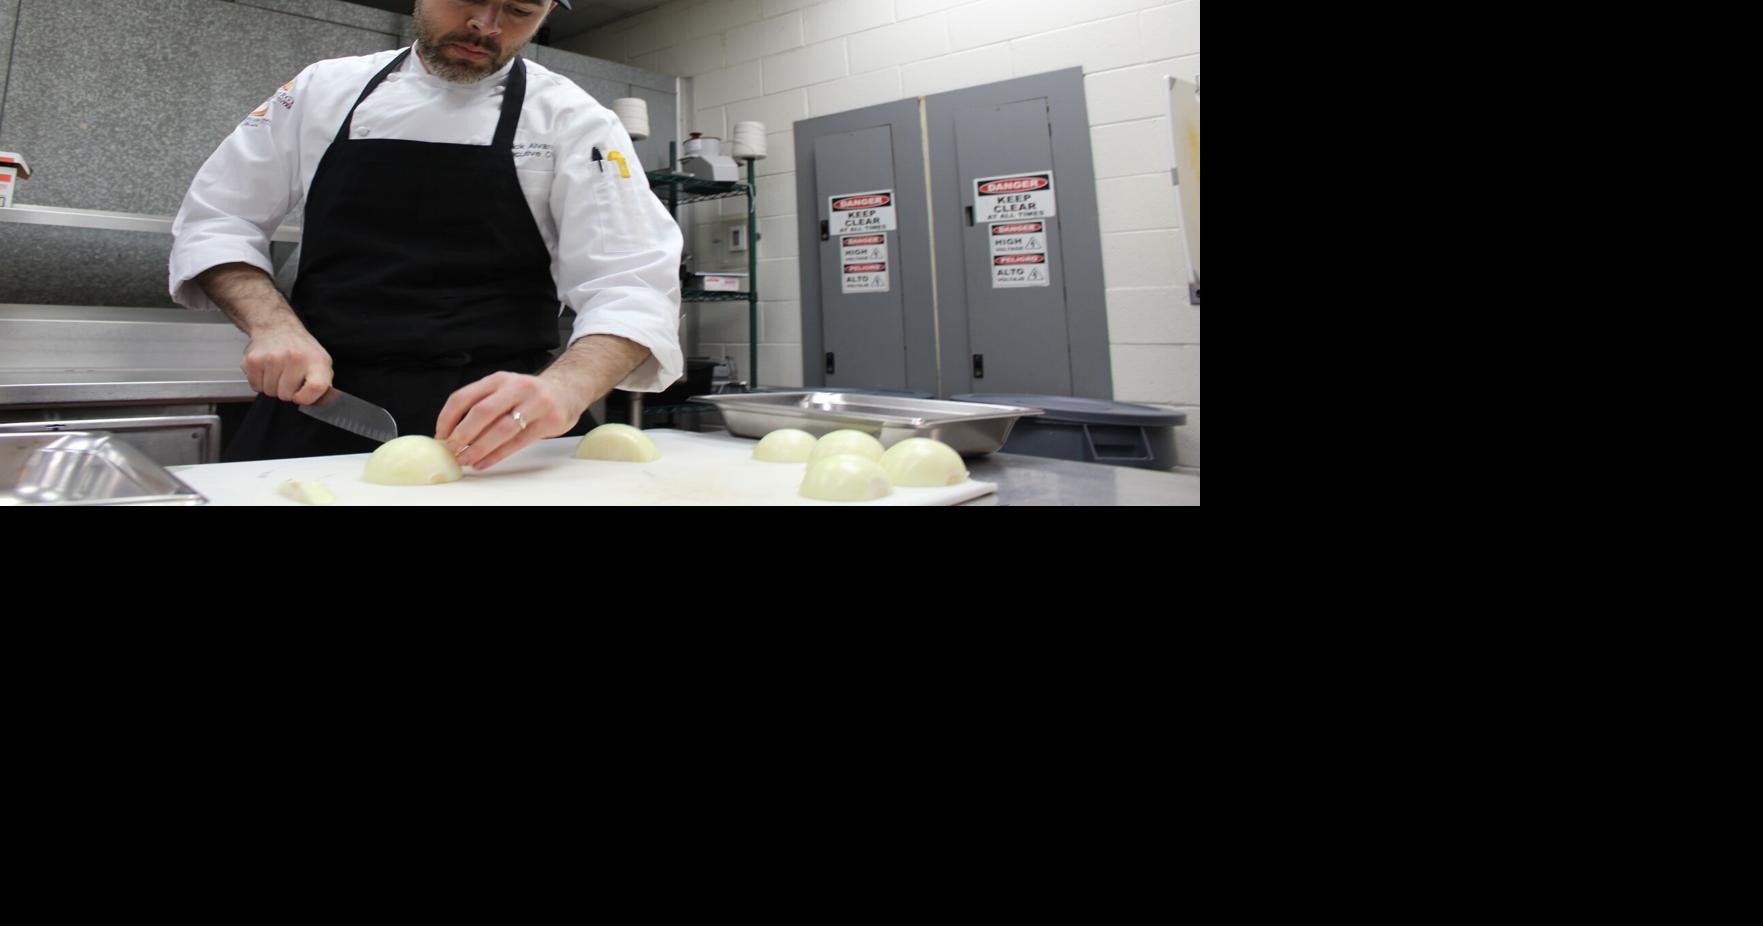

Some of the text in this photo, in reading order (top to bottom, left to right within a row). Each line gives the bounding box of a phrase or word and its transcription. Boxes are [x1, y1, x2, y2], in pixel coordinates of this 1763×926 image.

[988, 179, 1037, 191] DANGER
[840, 197, 881, 208] DANGER
[997, 194, 1031, 204] KEEP
[993, 202, 1036, 213] CLEAR
[848, 210, 876, 218] KEEP
[845, 218, 880, 226] CLEAR
[998, 224, 1035, 233] DANGER
[848, 237, 879, 245] DANGER
[995, 238, 1022, 246] HIGH
[1000, 256, 1037, 264] PELIGRO
[997, 268, 1024, 276] ALTO
